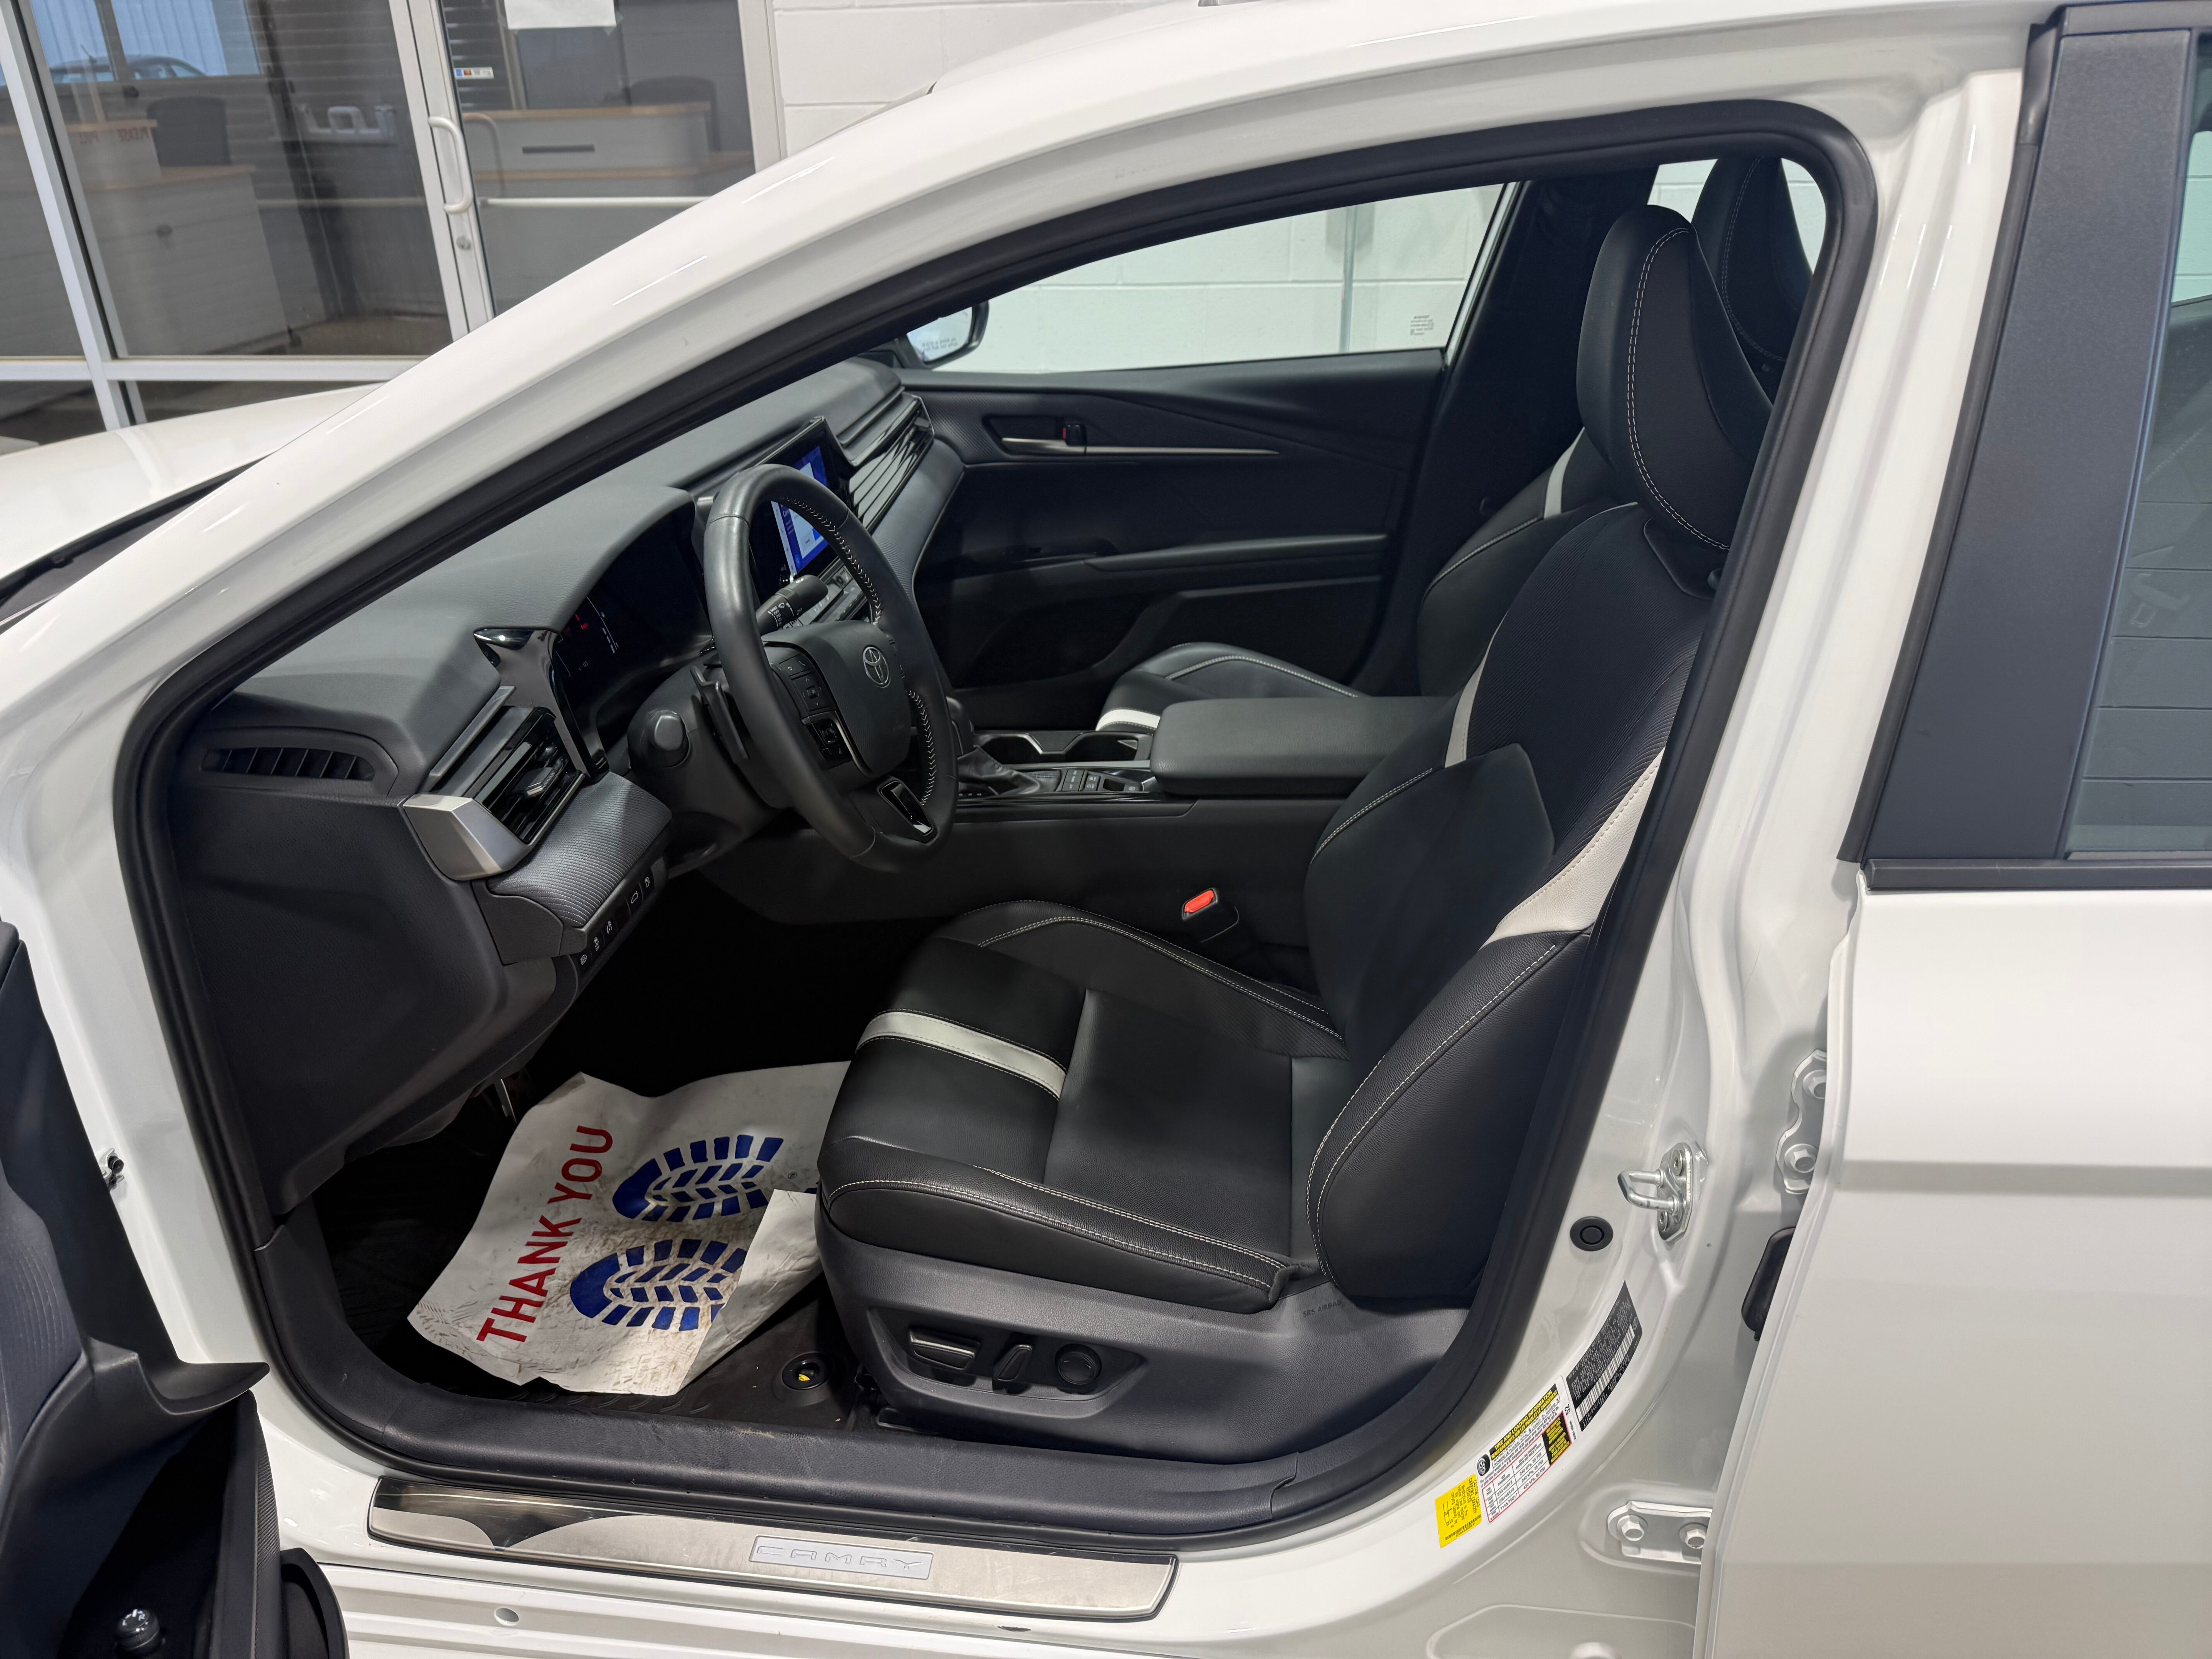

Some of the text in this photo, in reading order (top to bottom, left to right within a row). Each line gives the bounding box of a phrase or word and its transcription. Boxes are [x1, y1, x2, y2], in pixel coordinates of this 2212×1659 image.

[477, 1125, 614, 1343] THANK YOU
[1303, 1309, 1315, 1317] SRS
[1494, 1439, 1503, 1451] TIRE
[1503, 1431, 1511, 1442] AND
[1511, 1415, 1528, 1434] LOADING
[1528, 1389, 1552, 1418] INFORMATION
[1565, 1404, 1571, 1415] 52
[757, 1546, 924, 1569] CAMRY
